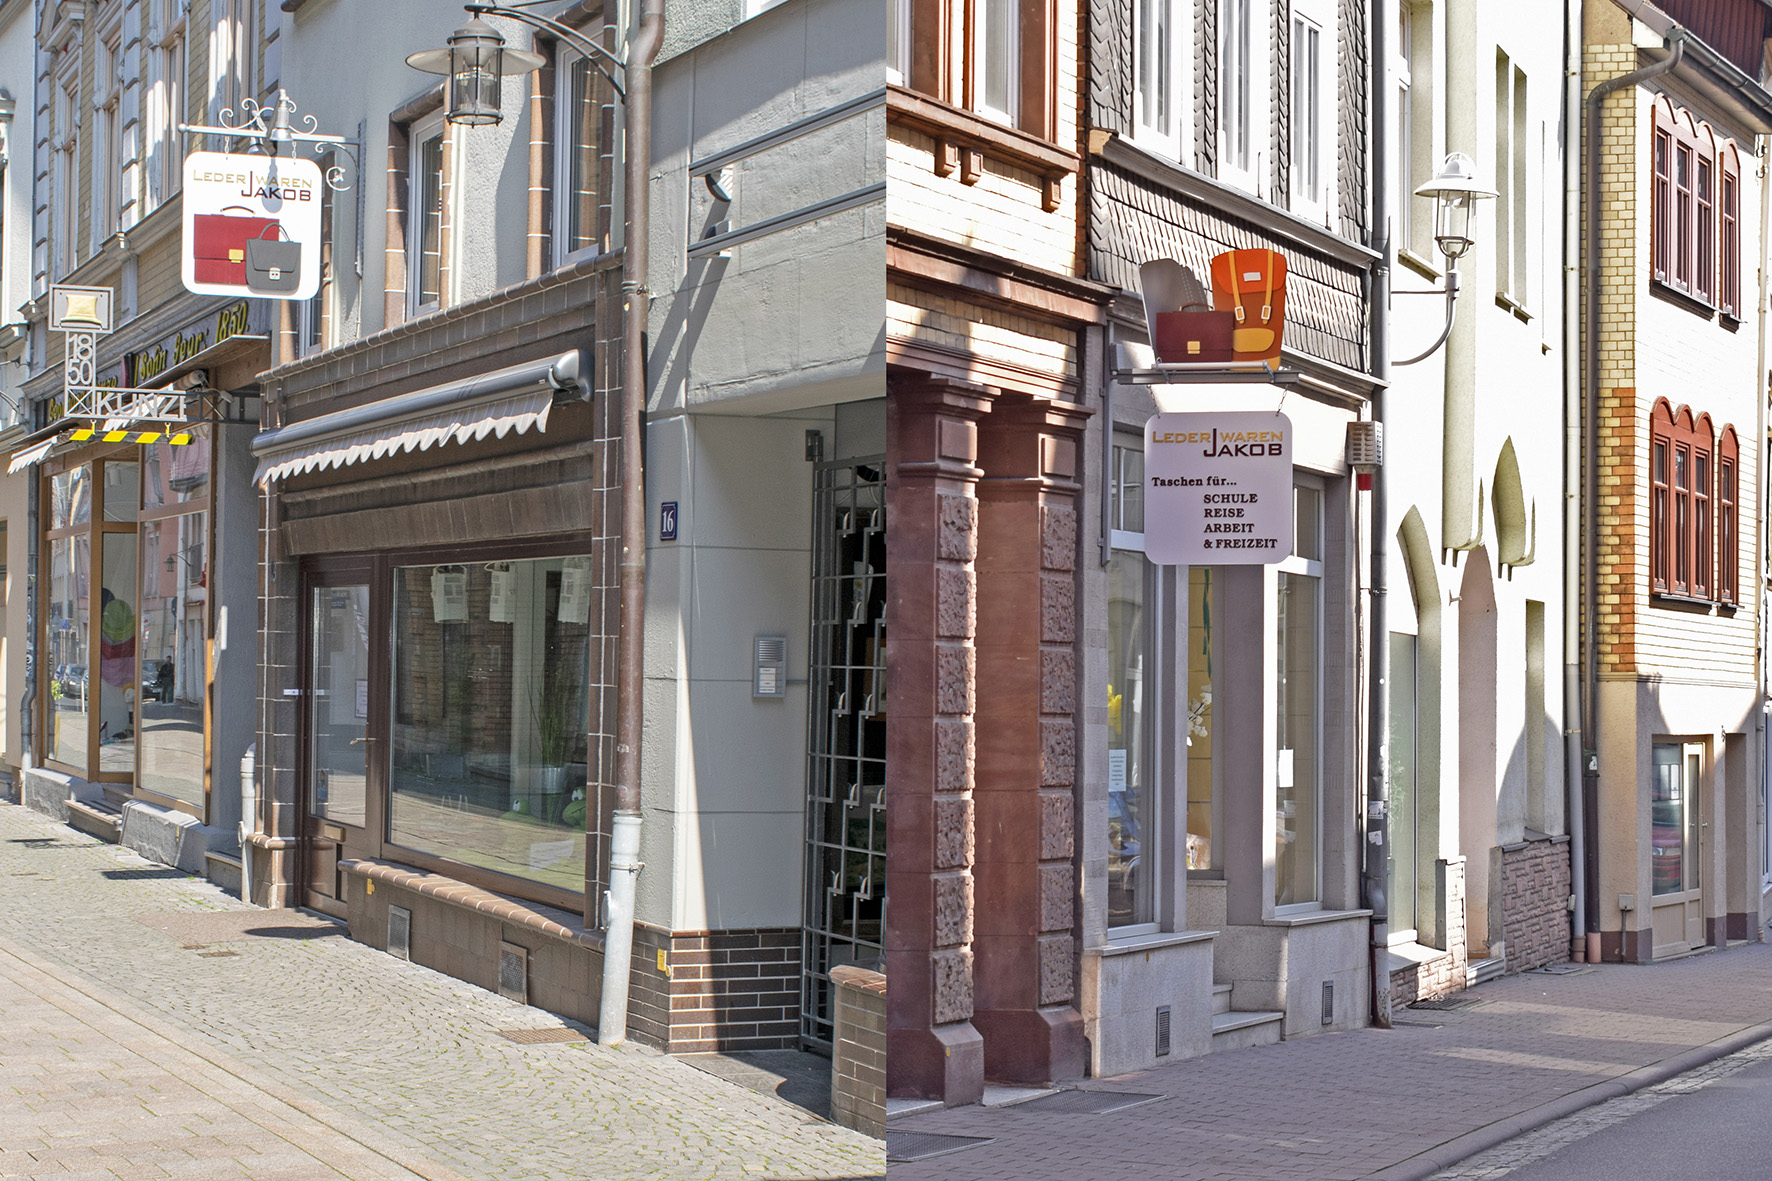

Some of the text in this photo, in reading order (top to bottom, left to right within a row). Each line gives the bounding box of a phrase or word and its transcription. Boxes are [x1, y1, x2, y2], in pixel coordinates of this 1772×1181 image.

[193, 169, 313, 188] LEDER WAREN
[241, 170, 311, 202] JAKOB
[68, 334, 93, 362] 18
[68, 358, 93, 386] 50
[97, 391, 197, 420] KUNZE
[1153, 431, 1283, 443] LEDER WAREN
[1203, 428, 1283, 457] JAKOB
[1152, 476, 1237, 487] Taschen für...
[1203, 493, 1258, 504] SCHULE
[662, 510, 674, 532] 16
[1203, 508, 1245, 518] REISE
[1203, 523, 1255, 533] ARBEIT
[1203, 538, 1278, 549] & FREIZEIT
